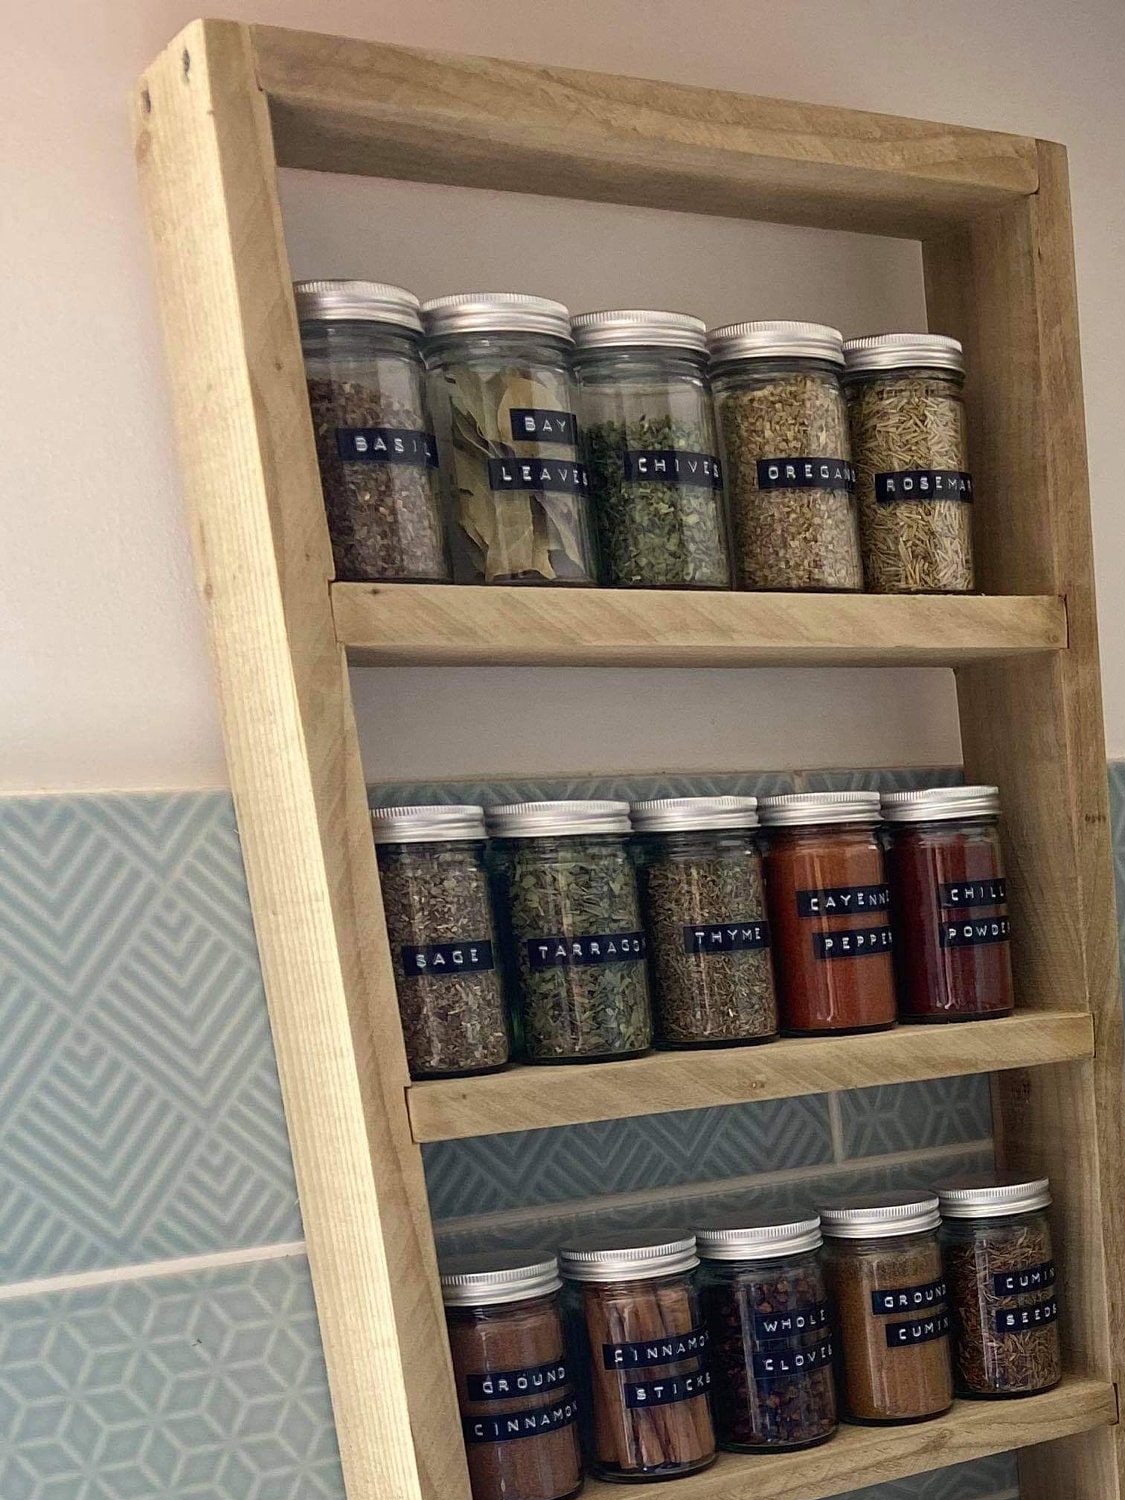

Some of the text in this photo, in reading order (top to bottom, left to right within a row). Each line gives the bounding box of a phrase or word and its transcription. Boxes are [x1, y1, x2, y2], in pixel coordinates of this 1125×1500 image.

[523, 415, 567, 433] BAY
[354, 436, 432, 458] BASIL
[637, 456, 720, 479] CHIVES
[694, 927, 762, 945] THYME
[415, 948, 480, 969] SAGE
[763, 1309, 826, 1333] WHOLE
[481, 1366, 566, 1394] GROUND
[635, 1371, 712, 1400] STICKS
